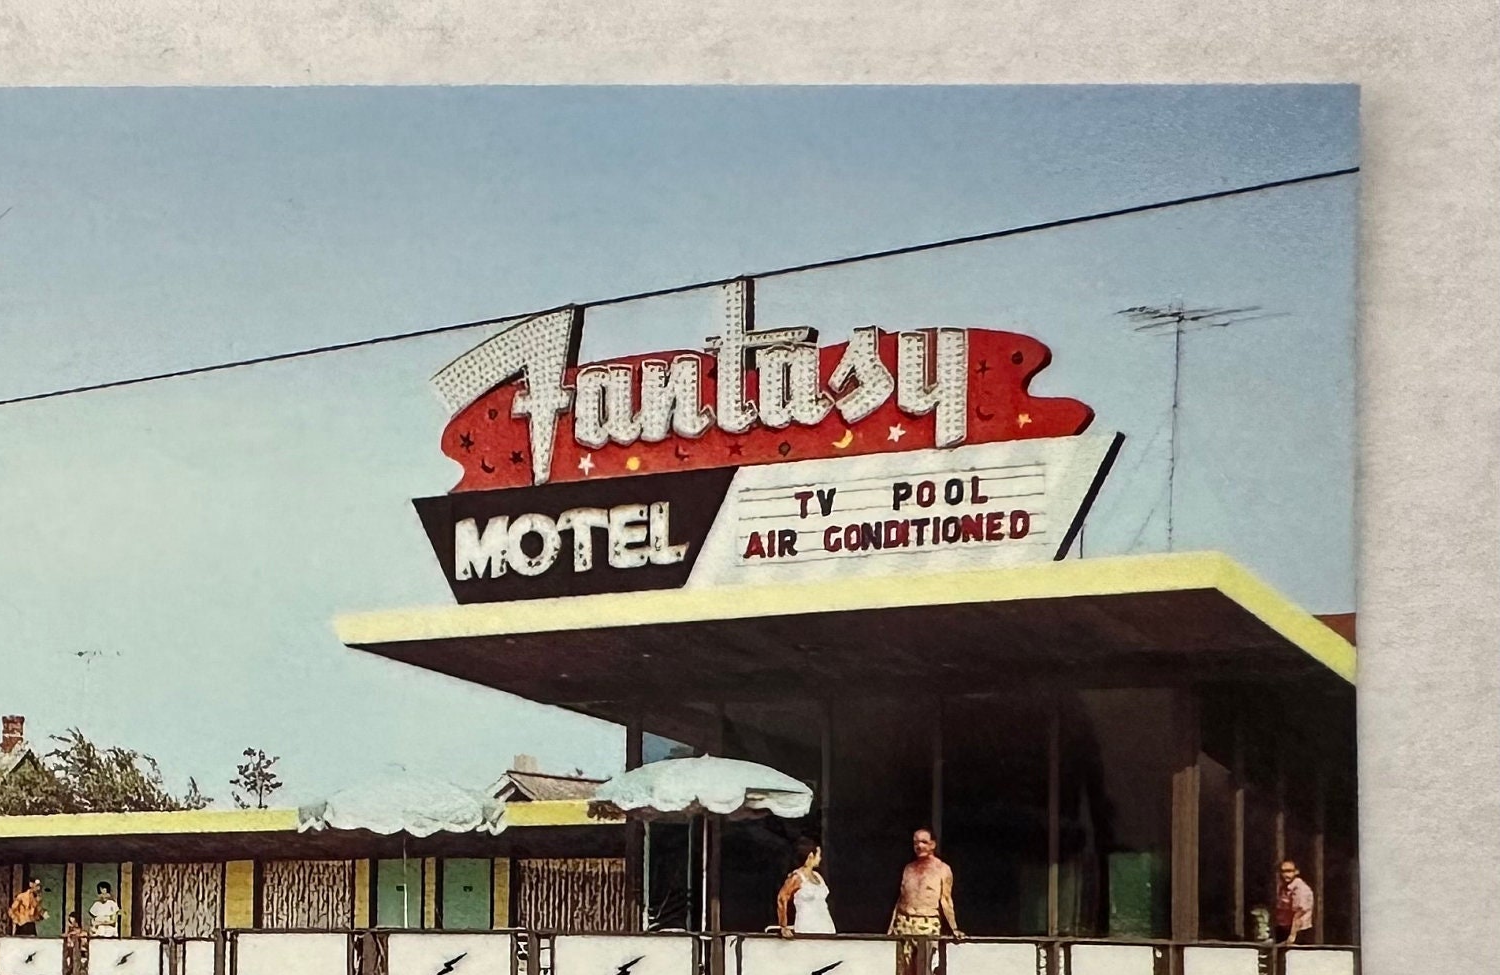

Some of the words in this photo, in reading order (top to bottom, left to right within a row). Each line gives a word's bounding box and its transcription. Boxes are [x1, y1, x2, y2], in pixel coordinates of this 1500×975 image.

[430, 278, 968, 485] Fantasy
[794, 487, 837, 519] TV
[892, 475, 989, 511] POOL
[455, 501, 690, 581] MOTEL
[743, 528, 799, 559] AIR
